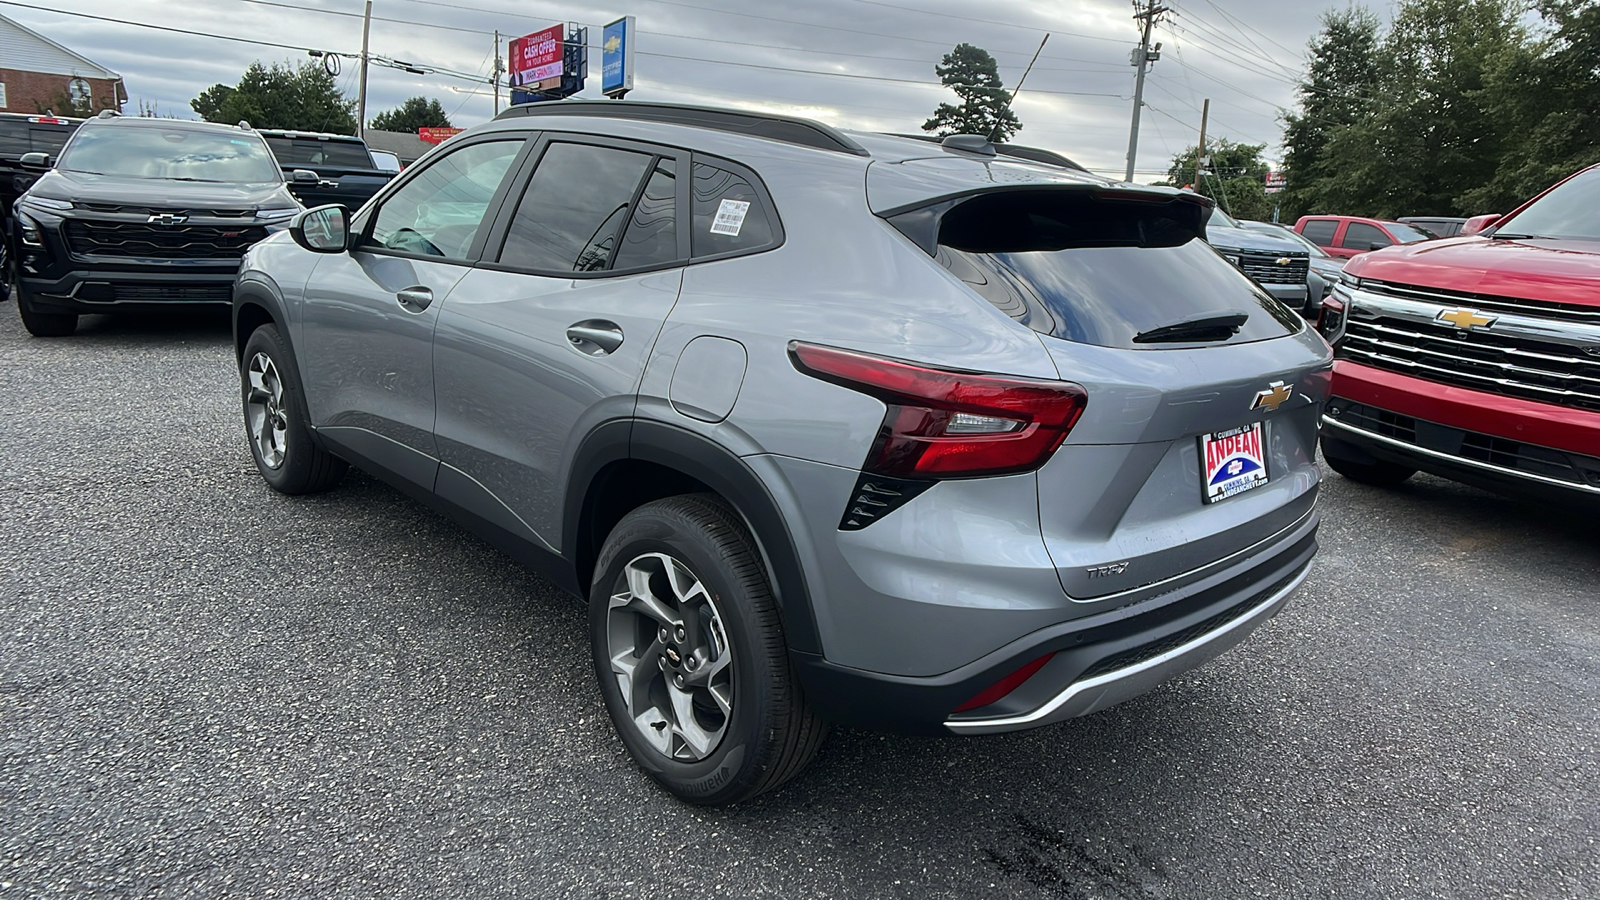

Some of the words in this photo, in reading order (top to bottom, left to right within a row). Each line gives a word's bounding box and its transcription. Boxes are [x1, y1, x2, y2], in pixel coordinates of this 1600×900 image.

[524, 44, 538, 60] CASH
[539, 38, 556, 55] OFFER
[1206, 426, 1262, 480] ANDEAN
[676, 772, 724, 795] Hankoo
